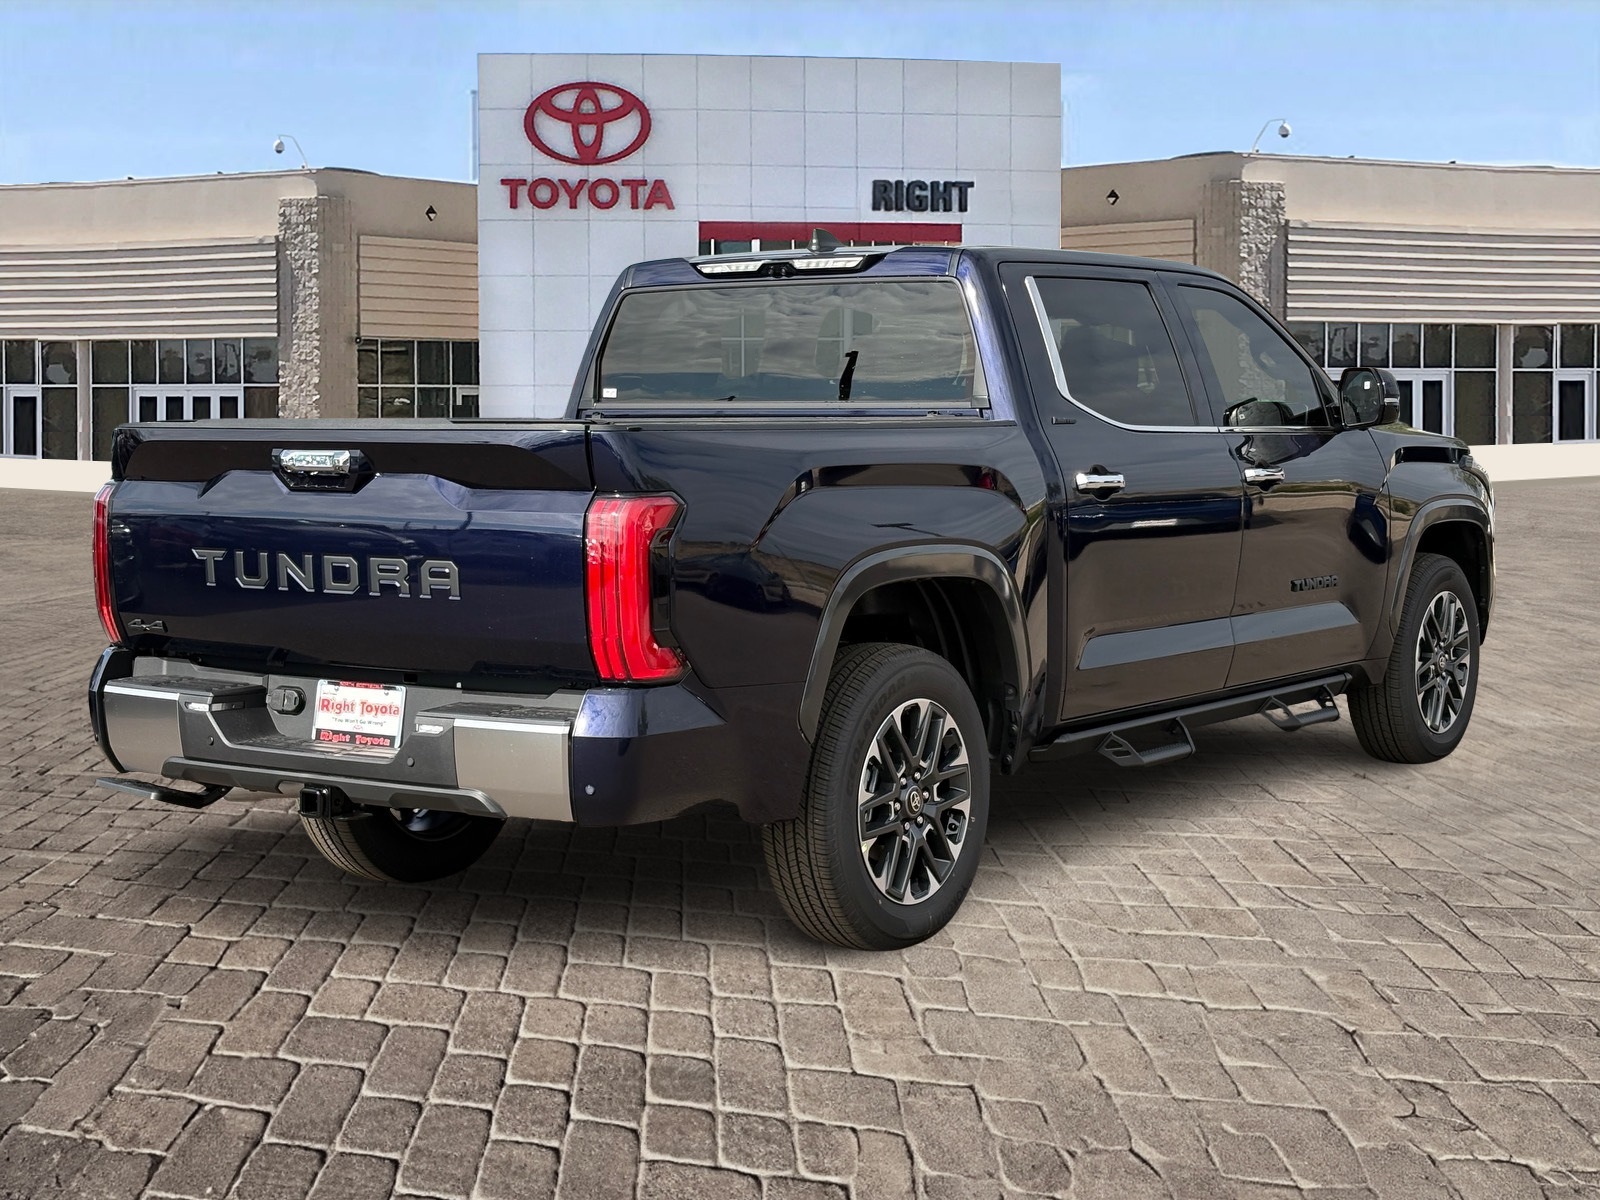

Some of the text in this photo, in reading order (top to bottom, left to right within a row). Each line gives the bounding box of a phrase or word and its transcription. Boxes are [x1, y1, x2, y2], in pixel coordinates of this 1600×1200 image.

[501, 178, 675, 210] TOYOTA
[871, 179, 975, 213] RIGHT
[191, 548, 461, 600] TUNDRA
[1290, 575, 1338, 592] TUNDRA
[320, 698, 400, 717] Right Toyota
[320, 730, 391, 746] Right Toyota
